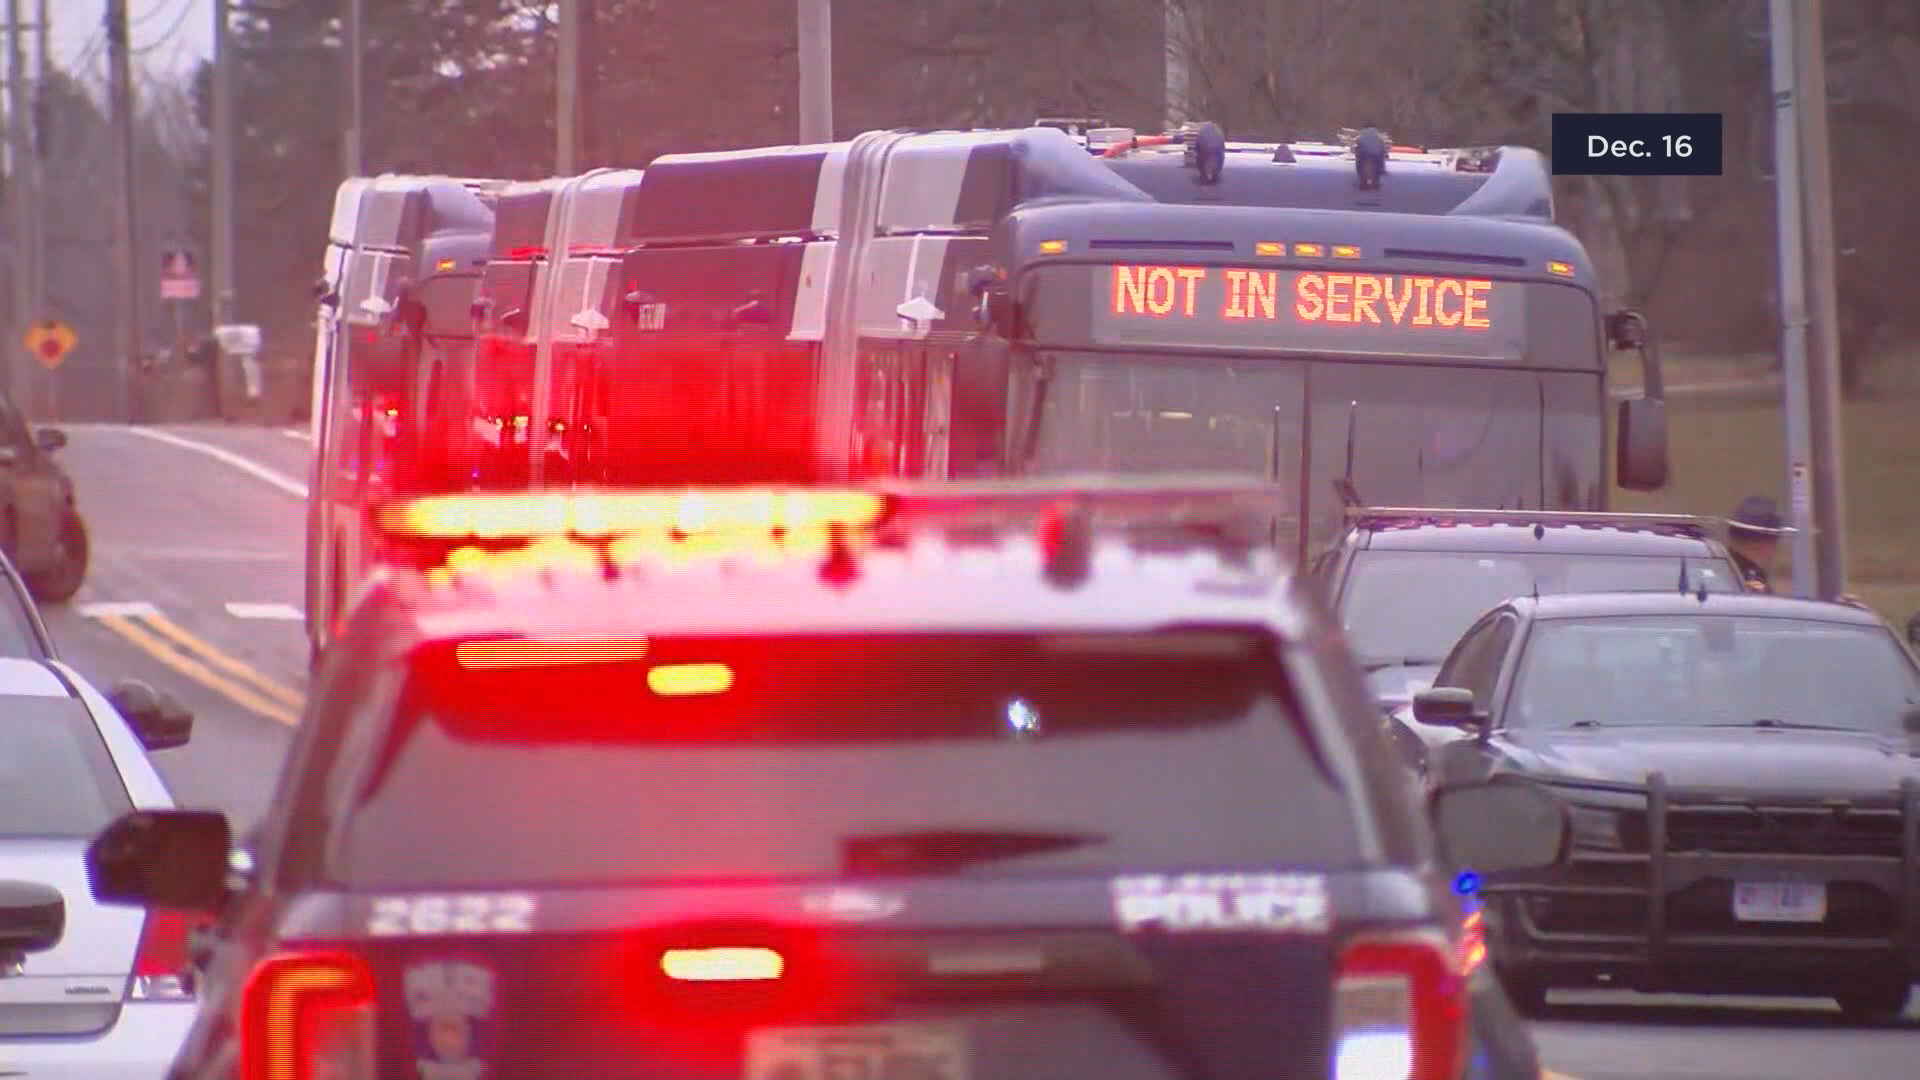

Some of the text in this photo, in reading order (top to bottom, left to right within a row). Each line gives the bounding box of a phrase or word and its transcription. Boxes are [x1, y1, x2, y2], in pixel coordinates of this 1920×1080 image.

[1113, 264, 1492, 328] NOT IN SERVICE
